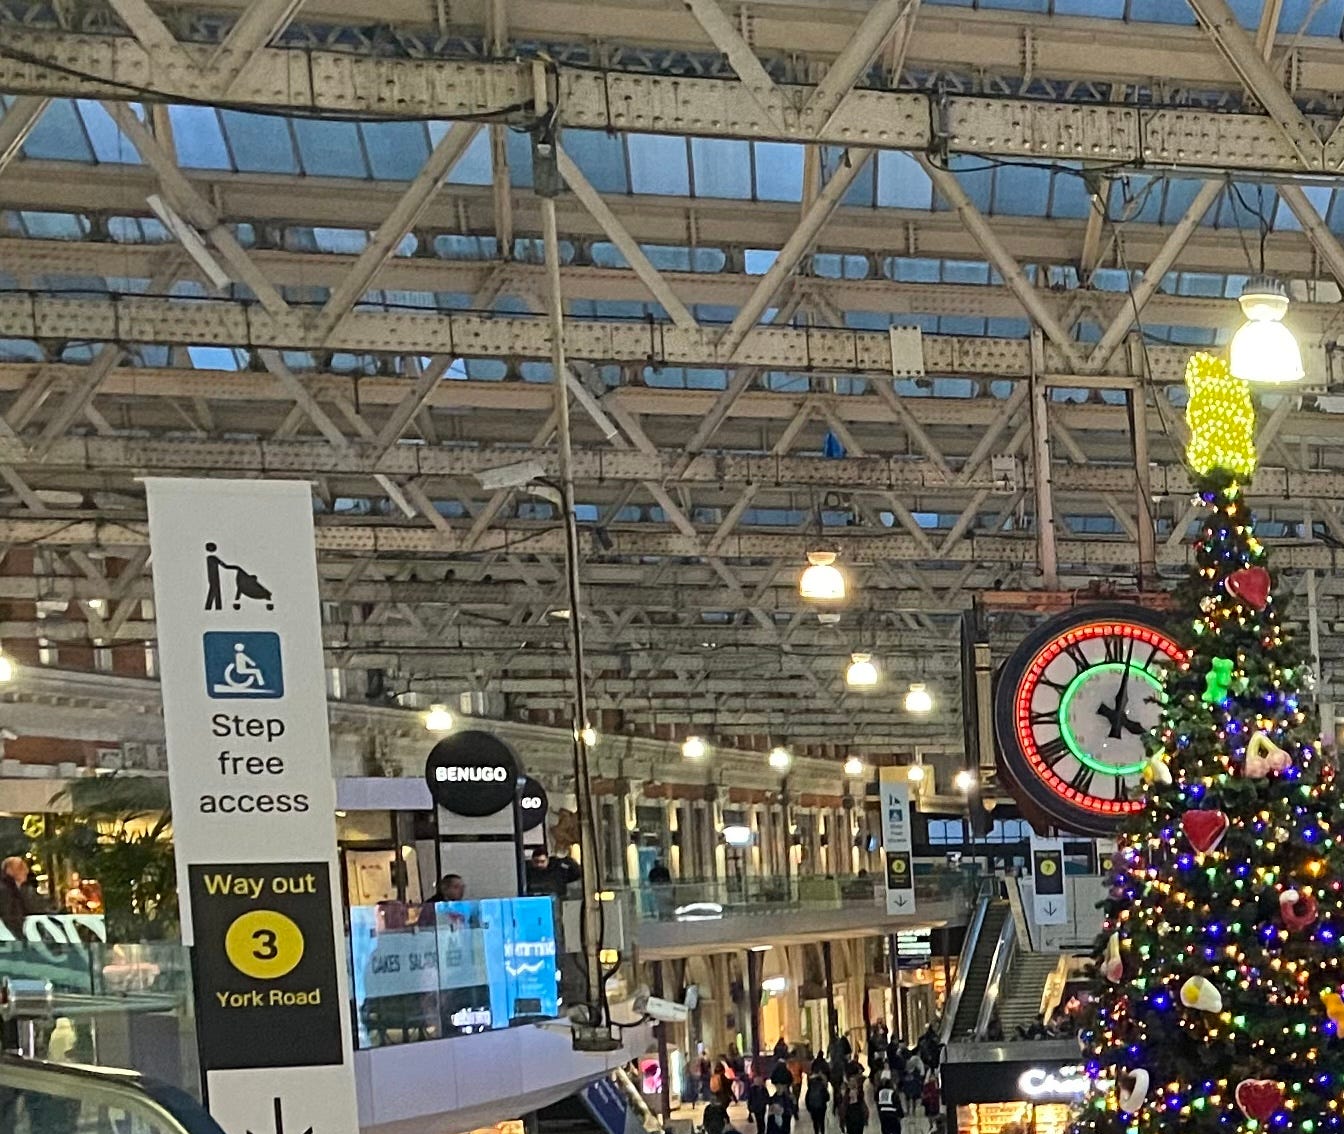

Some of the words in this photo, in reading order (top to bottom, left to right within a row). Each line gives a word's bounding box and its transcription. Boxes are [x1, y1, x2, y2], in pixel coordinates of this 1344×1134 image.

[212, 713, 285, 742] Step
[218, 751, 284, 775] free
[435, 766, 508, 781] BENUGO
[200, 793, 309, 813] access
[204, 874, 264, 899] Way
[272, 873, 316, 894] out
[251, 929, 278, 960] 3
[216, 990, 264, 1008] York
[269, 988, 321, 1006] Road
